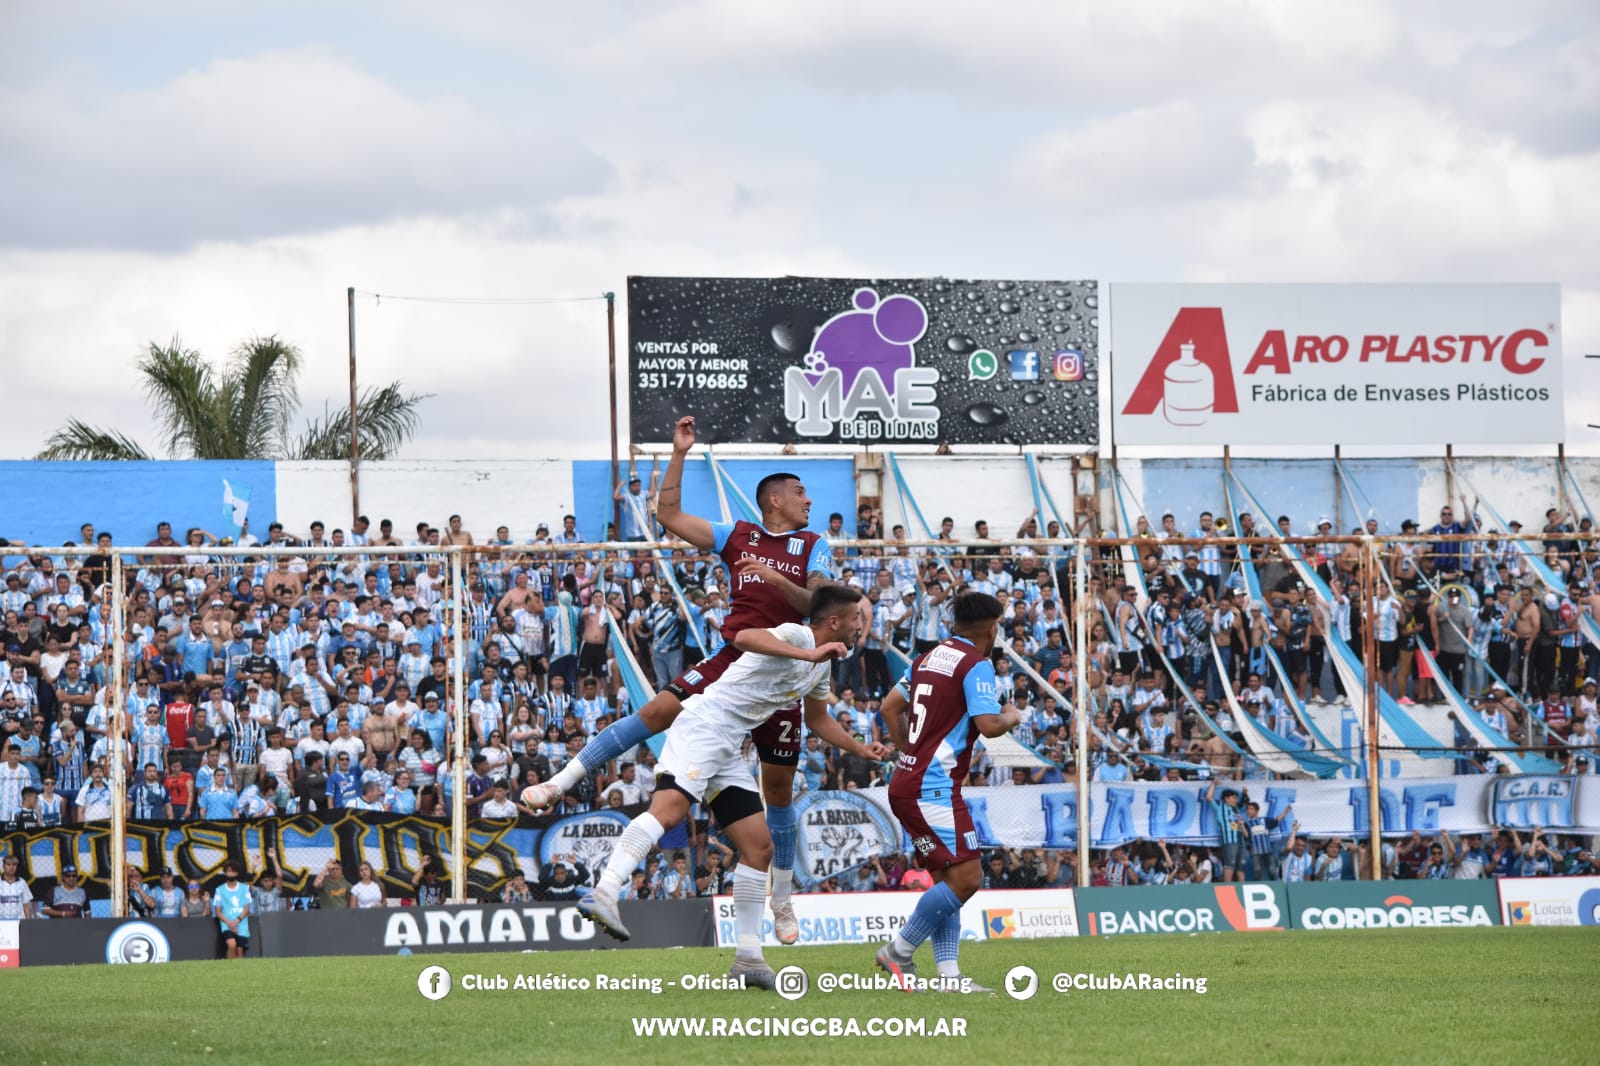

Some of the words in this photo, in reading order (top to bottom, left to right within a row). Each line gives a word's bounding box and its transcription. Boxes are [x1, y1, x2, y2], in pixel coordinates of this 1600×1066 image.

[638, 342, 688, 355] VENTAS
[692, 342, 718, 355] POR
[1244, 330, 1349, 374] ARO
[638, 358, 686, 372] MAYOR
[689, 359, 698, 371] Y
[701, 359, 748, 372] MENOR
[638, 373, 747, 389] 351-7196865
[1252, 384, 1327, 401] Fábrica
[1334, 385, 1358, 401] de
[1366, 384, 1450, 401] Envases
[1458, 383, 1550, 401] Plásticos
[840, 419, 938, 439] BEBIDAS
[908, 683, 933, 744] 5
[1508, 782, 1564, 798] C.A.R.
[808, 810, 825, 826] LA
[826, 808, 872, 825] BARRA
[562, 825, 580, 838] LA
[582, 823, 624, 837] BARRA
[808, 841, 822, 852] DE
[866, 915, 885, 930] ES
[1101, 908, 1215, 935] BANCOR
[1301, 903, 1493, 930] CORDOBESA
[384, 906, 596, 947] AMATO
[129, 939, 149, 964] 3
